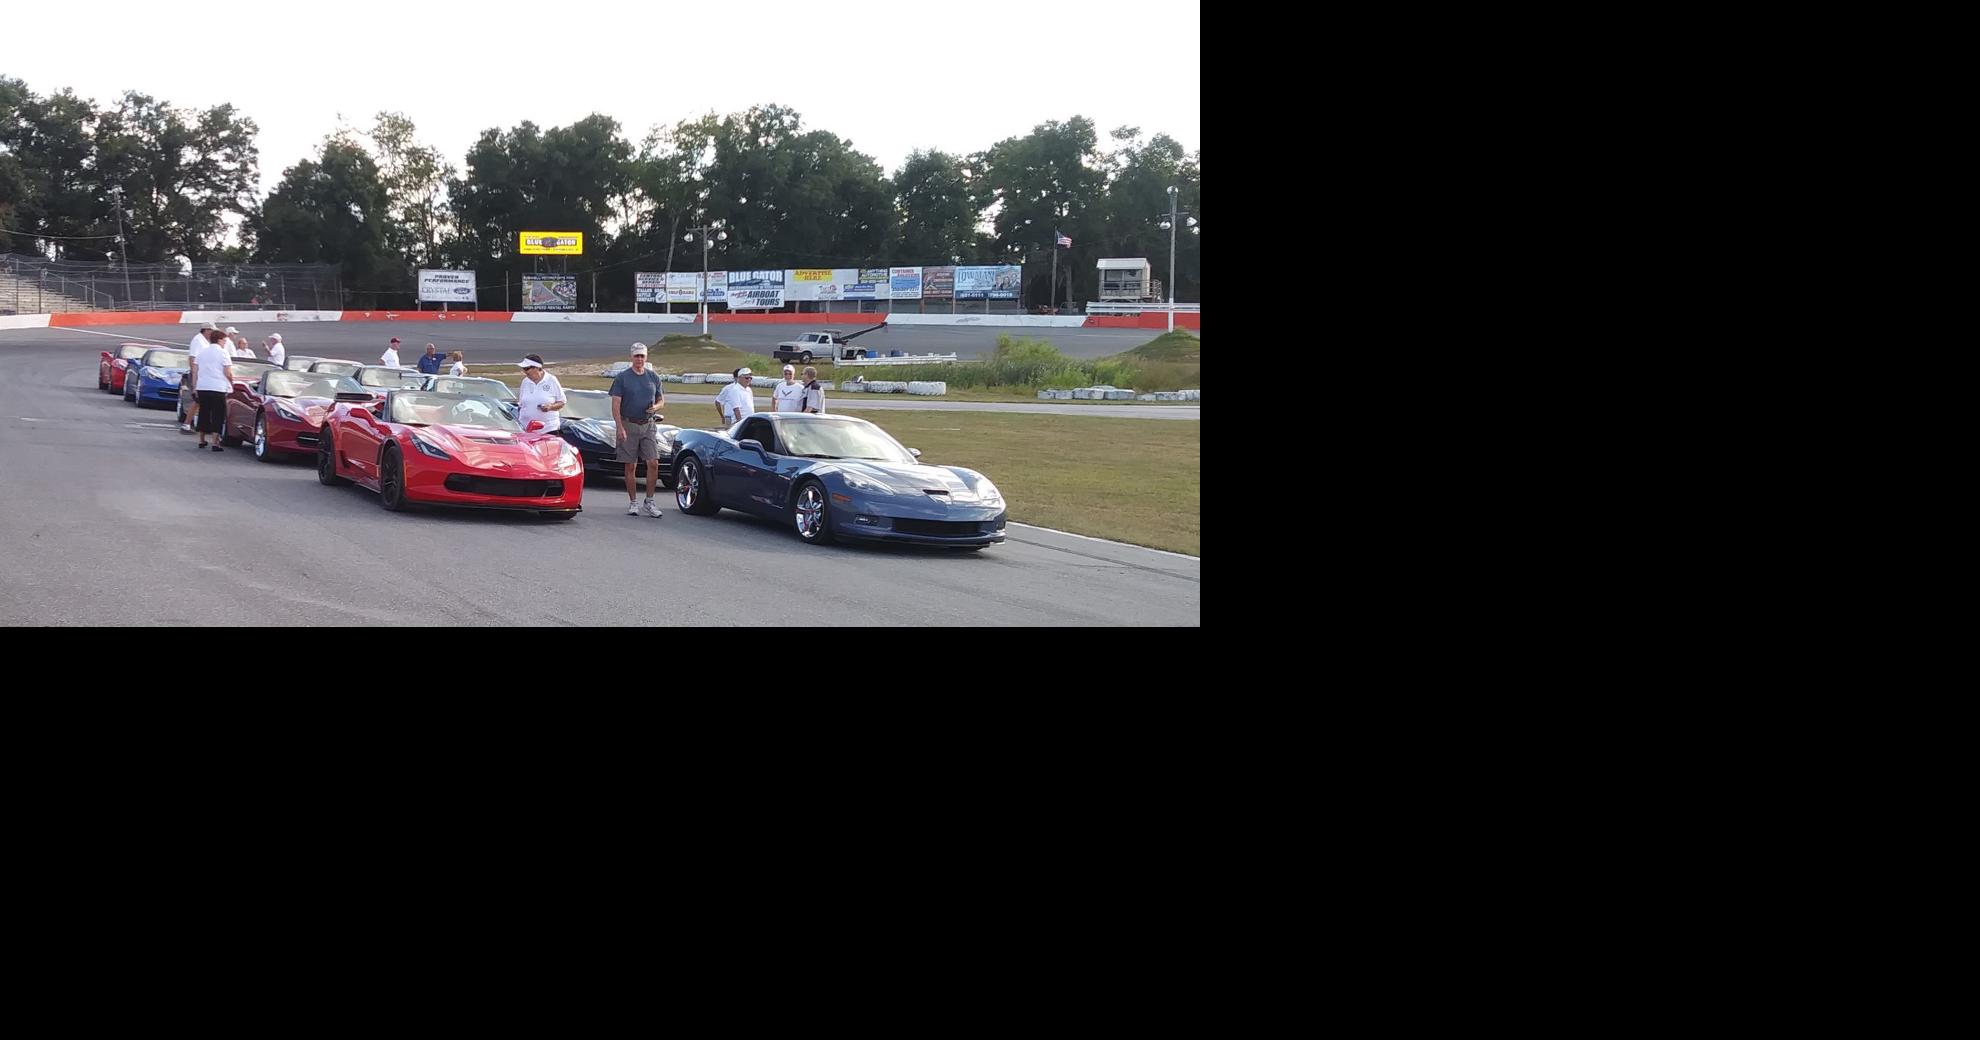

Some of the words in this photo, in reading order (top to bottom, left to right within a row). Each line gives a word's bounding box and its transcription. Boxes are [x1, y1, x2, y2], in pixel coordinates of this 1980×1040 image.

[729, 271, 752, 284] BLUE
[752, 270, 783, 282] GATOR
[747, 290, 780, 299] AIRBOAT
[756, 298, 780, 306] TOURS
